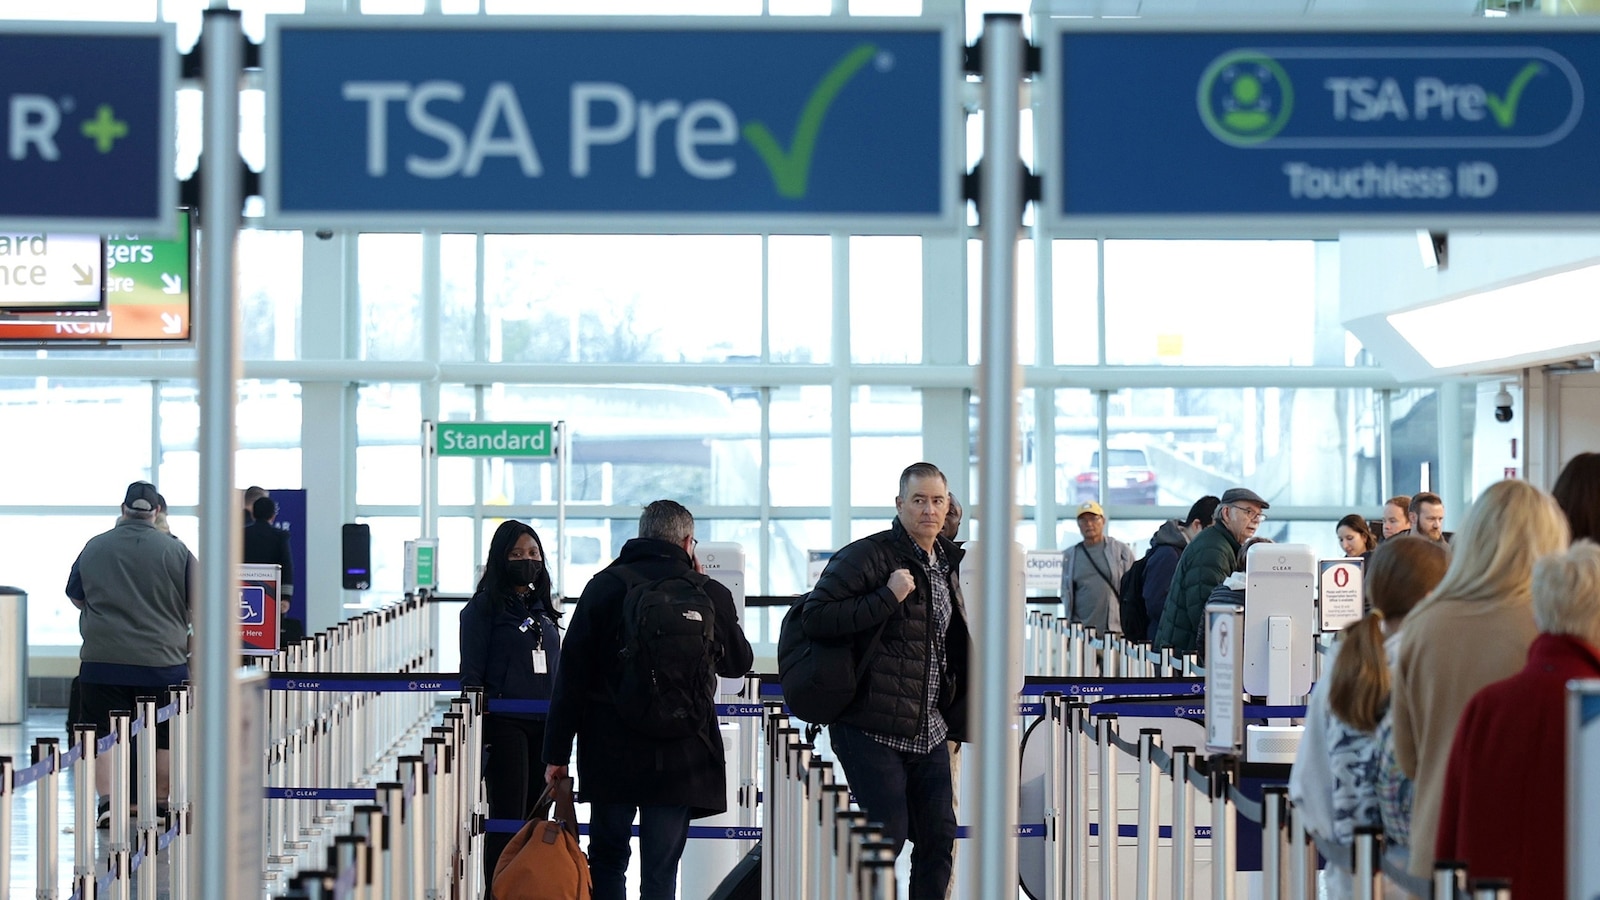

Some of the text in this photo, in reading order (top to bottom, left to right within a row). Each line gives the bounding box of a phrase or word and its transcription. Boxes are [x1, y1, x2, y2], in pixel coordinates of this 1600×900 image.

[1324, 77, 1408, 121] TSA
[341, 81, 739, 179] TSA Pre
[1283, 160, 1499, 199] Touchless ID
[443, 430, 544, 450] Standard
